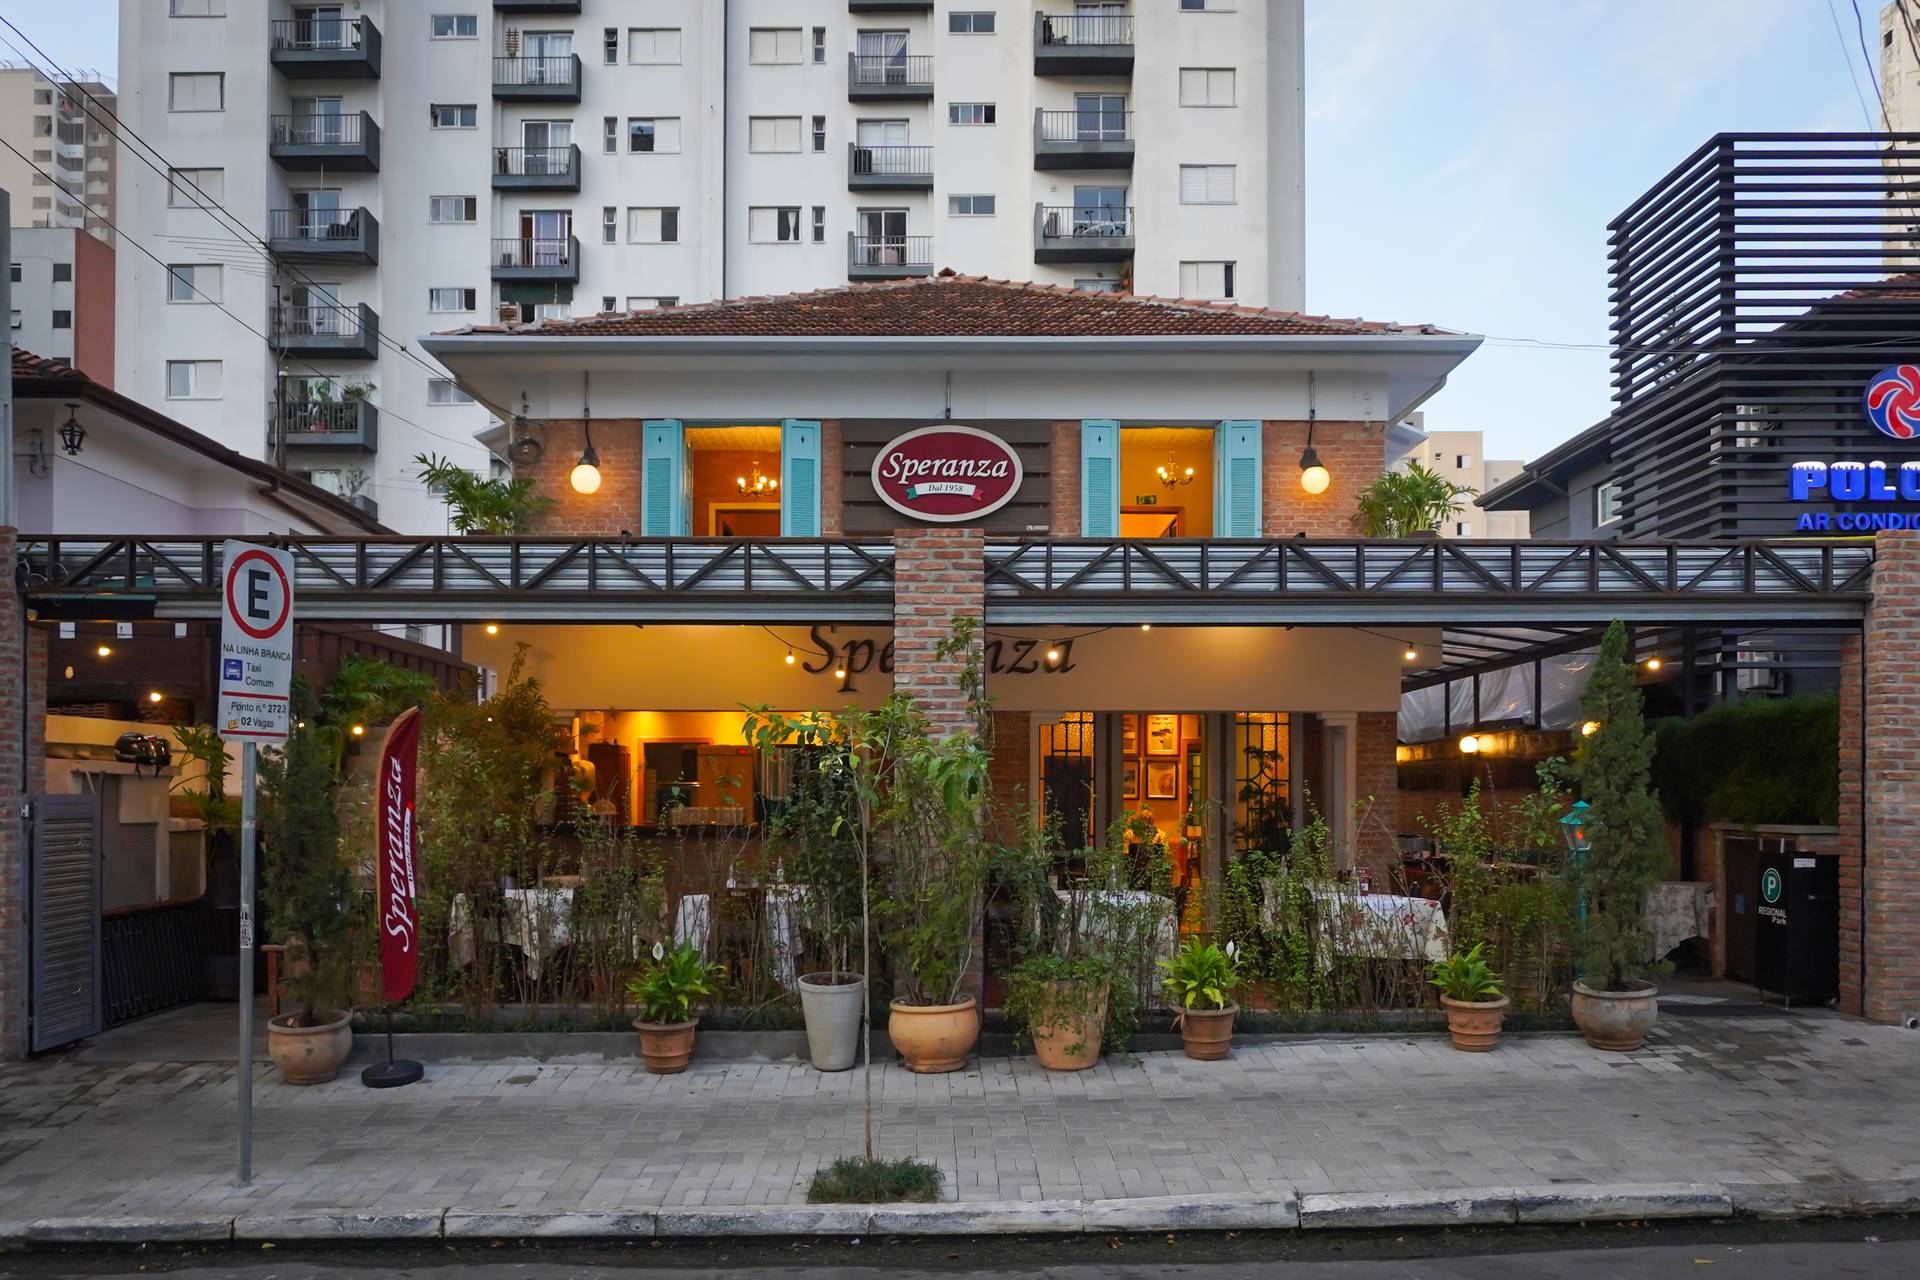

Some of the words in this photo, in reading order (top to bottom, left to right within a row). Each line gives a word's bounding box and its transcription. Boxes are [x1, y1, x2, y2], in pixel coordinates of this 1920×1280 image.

[882, 452, 1008, 485] Speranza
[928, 484, 943, 492] Dal
[945, 484, 964, 492] 1958
[1798, 512, 1830, 531] AR
[248, 568, 270, 620] E
[223, 643, 235, 653] NA
[236, 645, 260, 657] LINHA
[261, 648, 291, 661] BRANCA
[246, 662, 262, 672] Táxi
[245, 676, 274, 687] Comum
[231, 701, 255, 712] Ponto
[268, 704, 287, 713] 2723
[241, 716, 251, 726] 02
[253, 717, 275, 729] Vagas
[385, 756, 413, 952] Speranza
[1767, 876, 1776, 896] P
[1758, 906, 1787, 918] REGIONAL
[1772, 916, 1787, 925] Park
